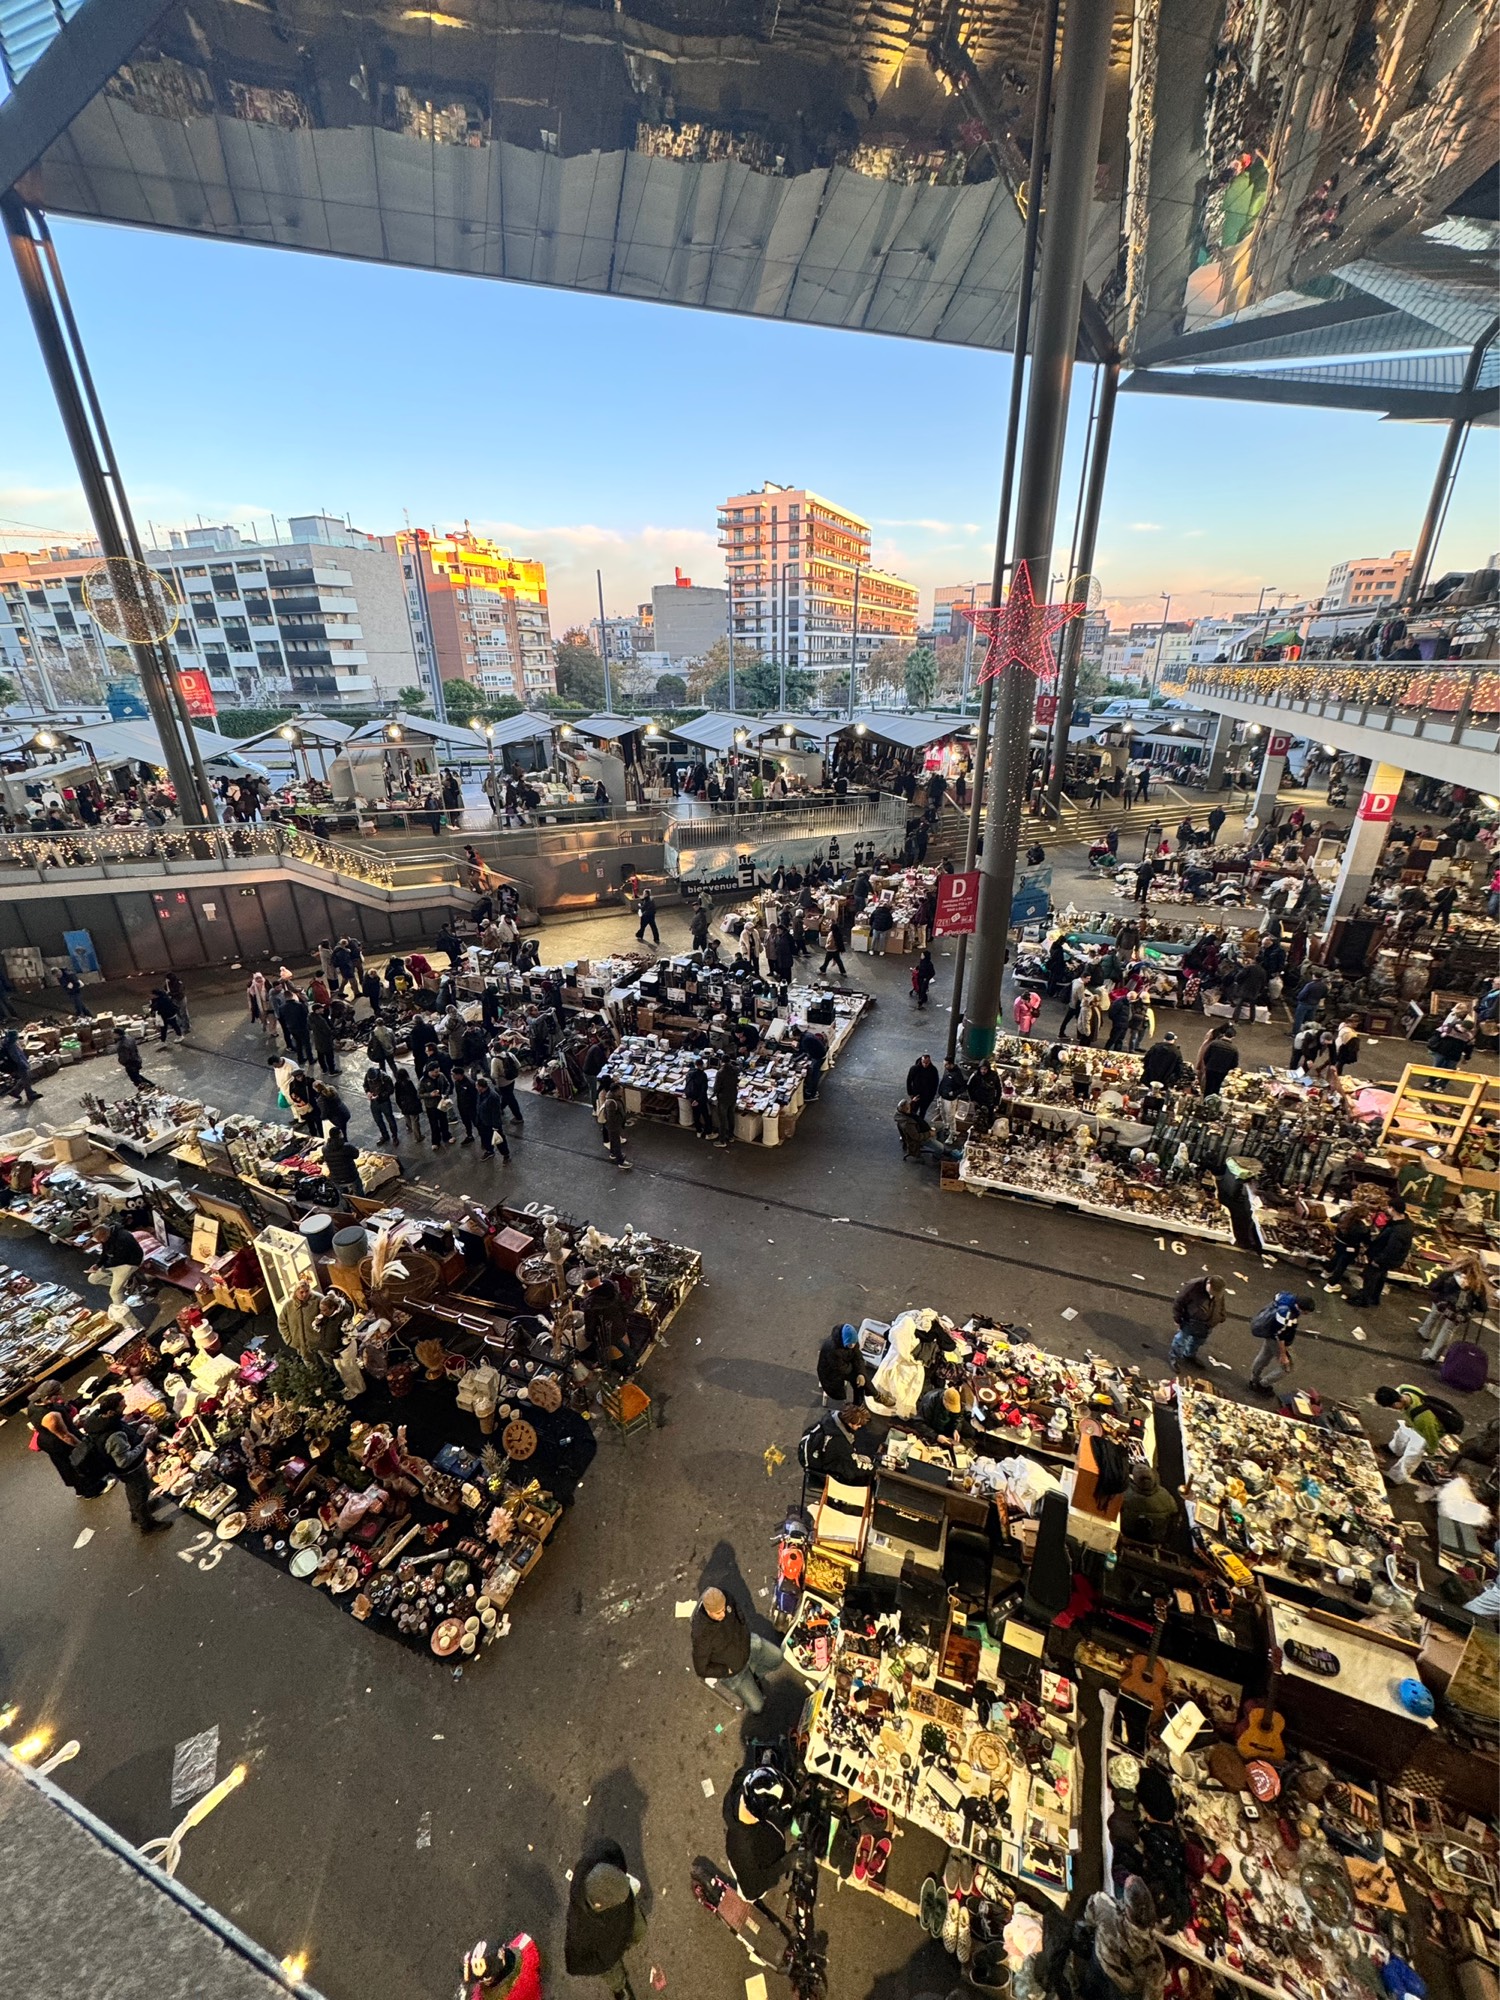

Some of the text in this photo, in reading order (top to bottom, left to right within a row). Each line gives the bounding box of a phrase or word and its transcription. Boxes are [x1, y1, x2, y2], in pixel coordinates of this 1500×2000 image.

[181, 676, 196, 690] D
[1043, 698, 1051, 708] D
[1274, 738, 1286, 750] D
[1371, 795, 1390, 813] D
[952, 879, 966, 897] D
[1153, 1236, 1187, 1256] 16
[177, 1531, 234, 1571] 25
